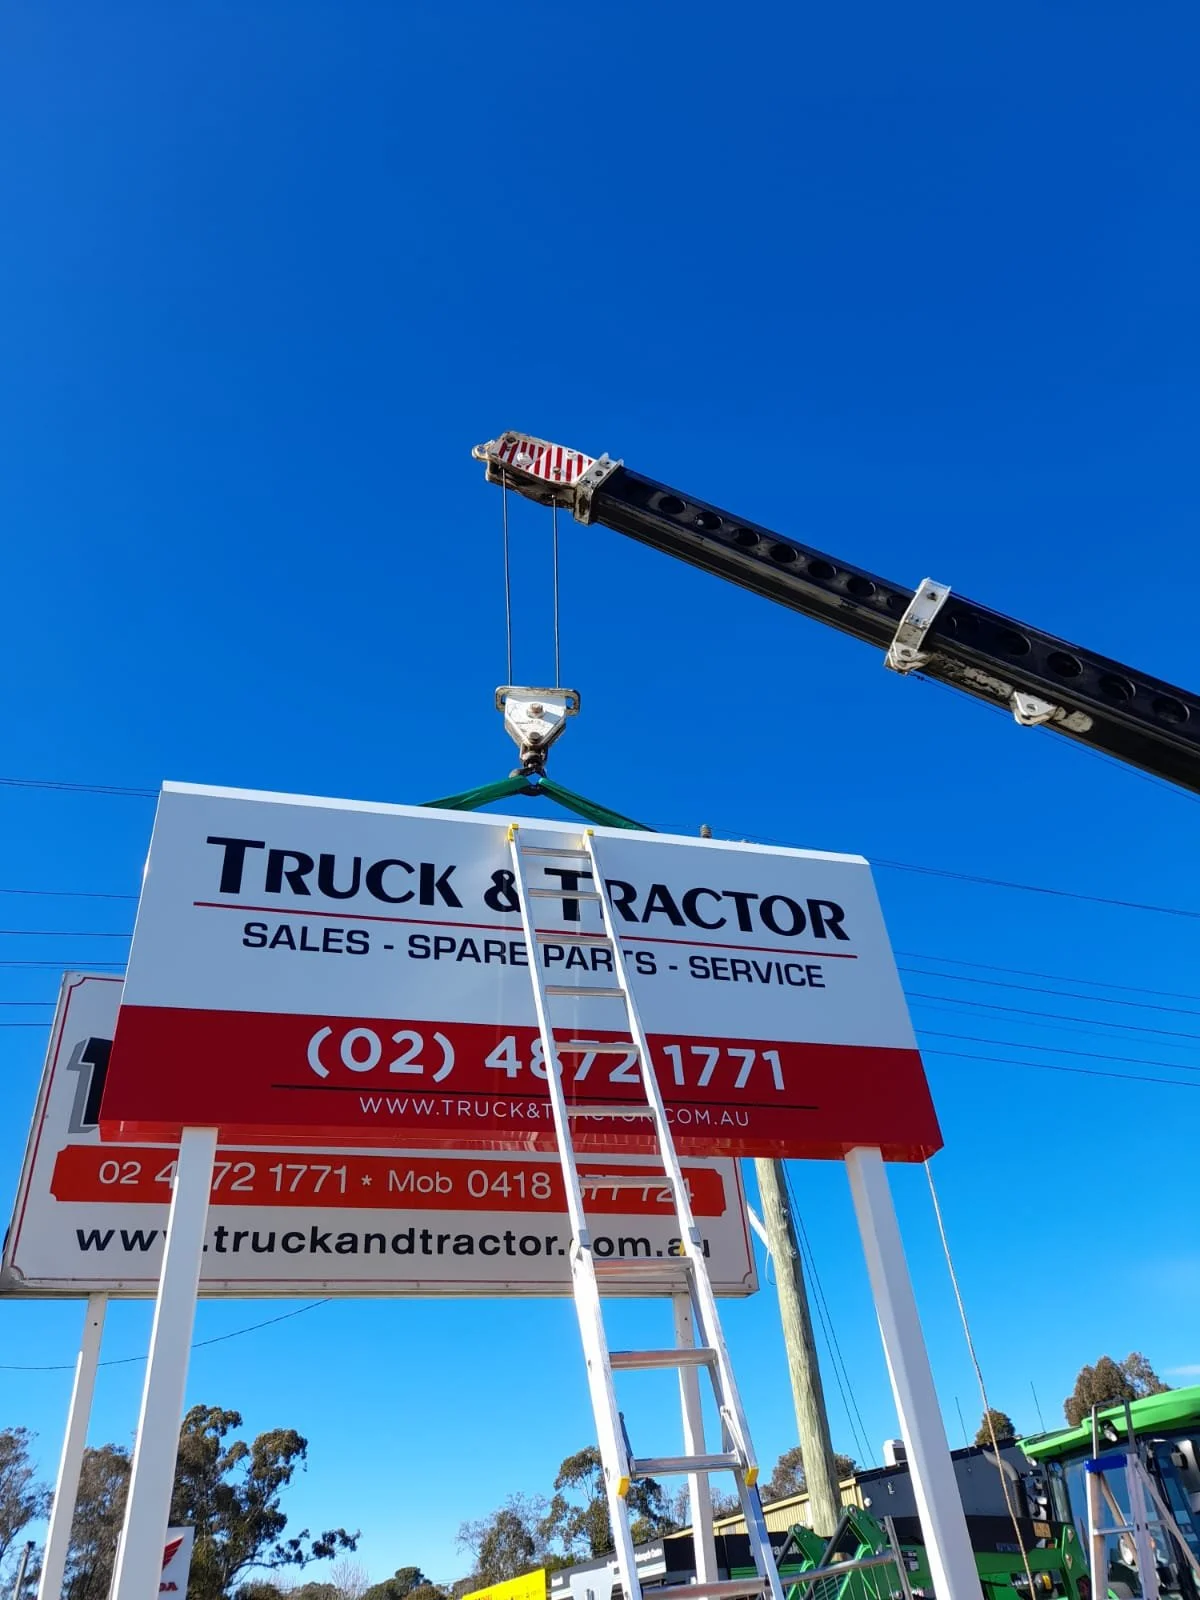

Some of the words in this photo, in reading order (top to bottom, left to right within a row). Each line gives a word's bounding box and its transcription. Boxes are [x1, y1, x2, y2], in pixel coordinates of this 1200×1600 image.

[206, 836, 463, 908] TRUCK
[484, 869, 522, 912] &
[544, 868, 850, 940] TRACTOR
[242, 922, 370, 956] SALES
[407, 934, 529, 967] SPARE
[688, 956, 827, 988] SERVICE
[307, 1026, 455, 1083] (02)
[663, 1044, 786, 1091] 1771
[98, 1160, 141, 1185] 02
[154, 1161, 255, 1192] 472
[270, 1163, 348, 1194] 1771
[388, 1169, 453, 1194] Mob
[467, 1169, 552, 1200] 0418
